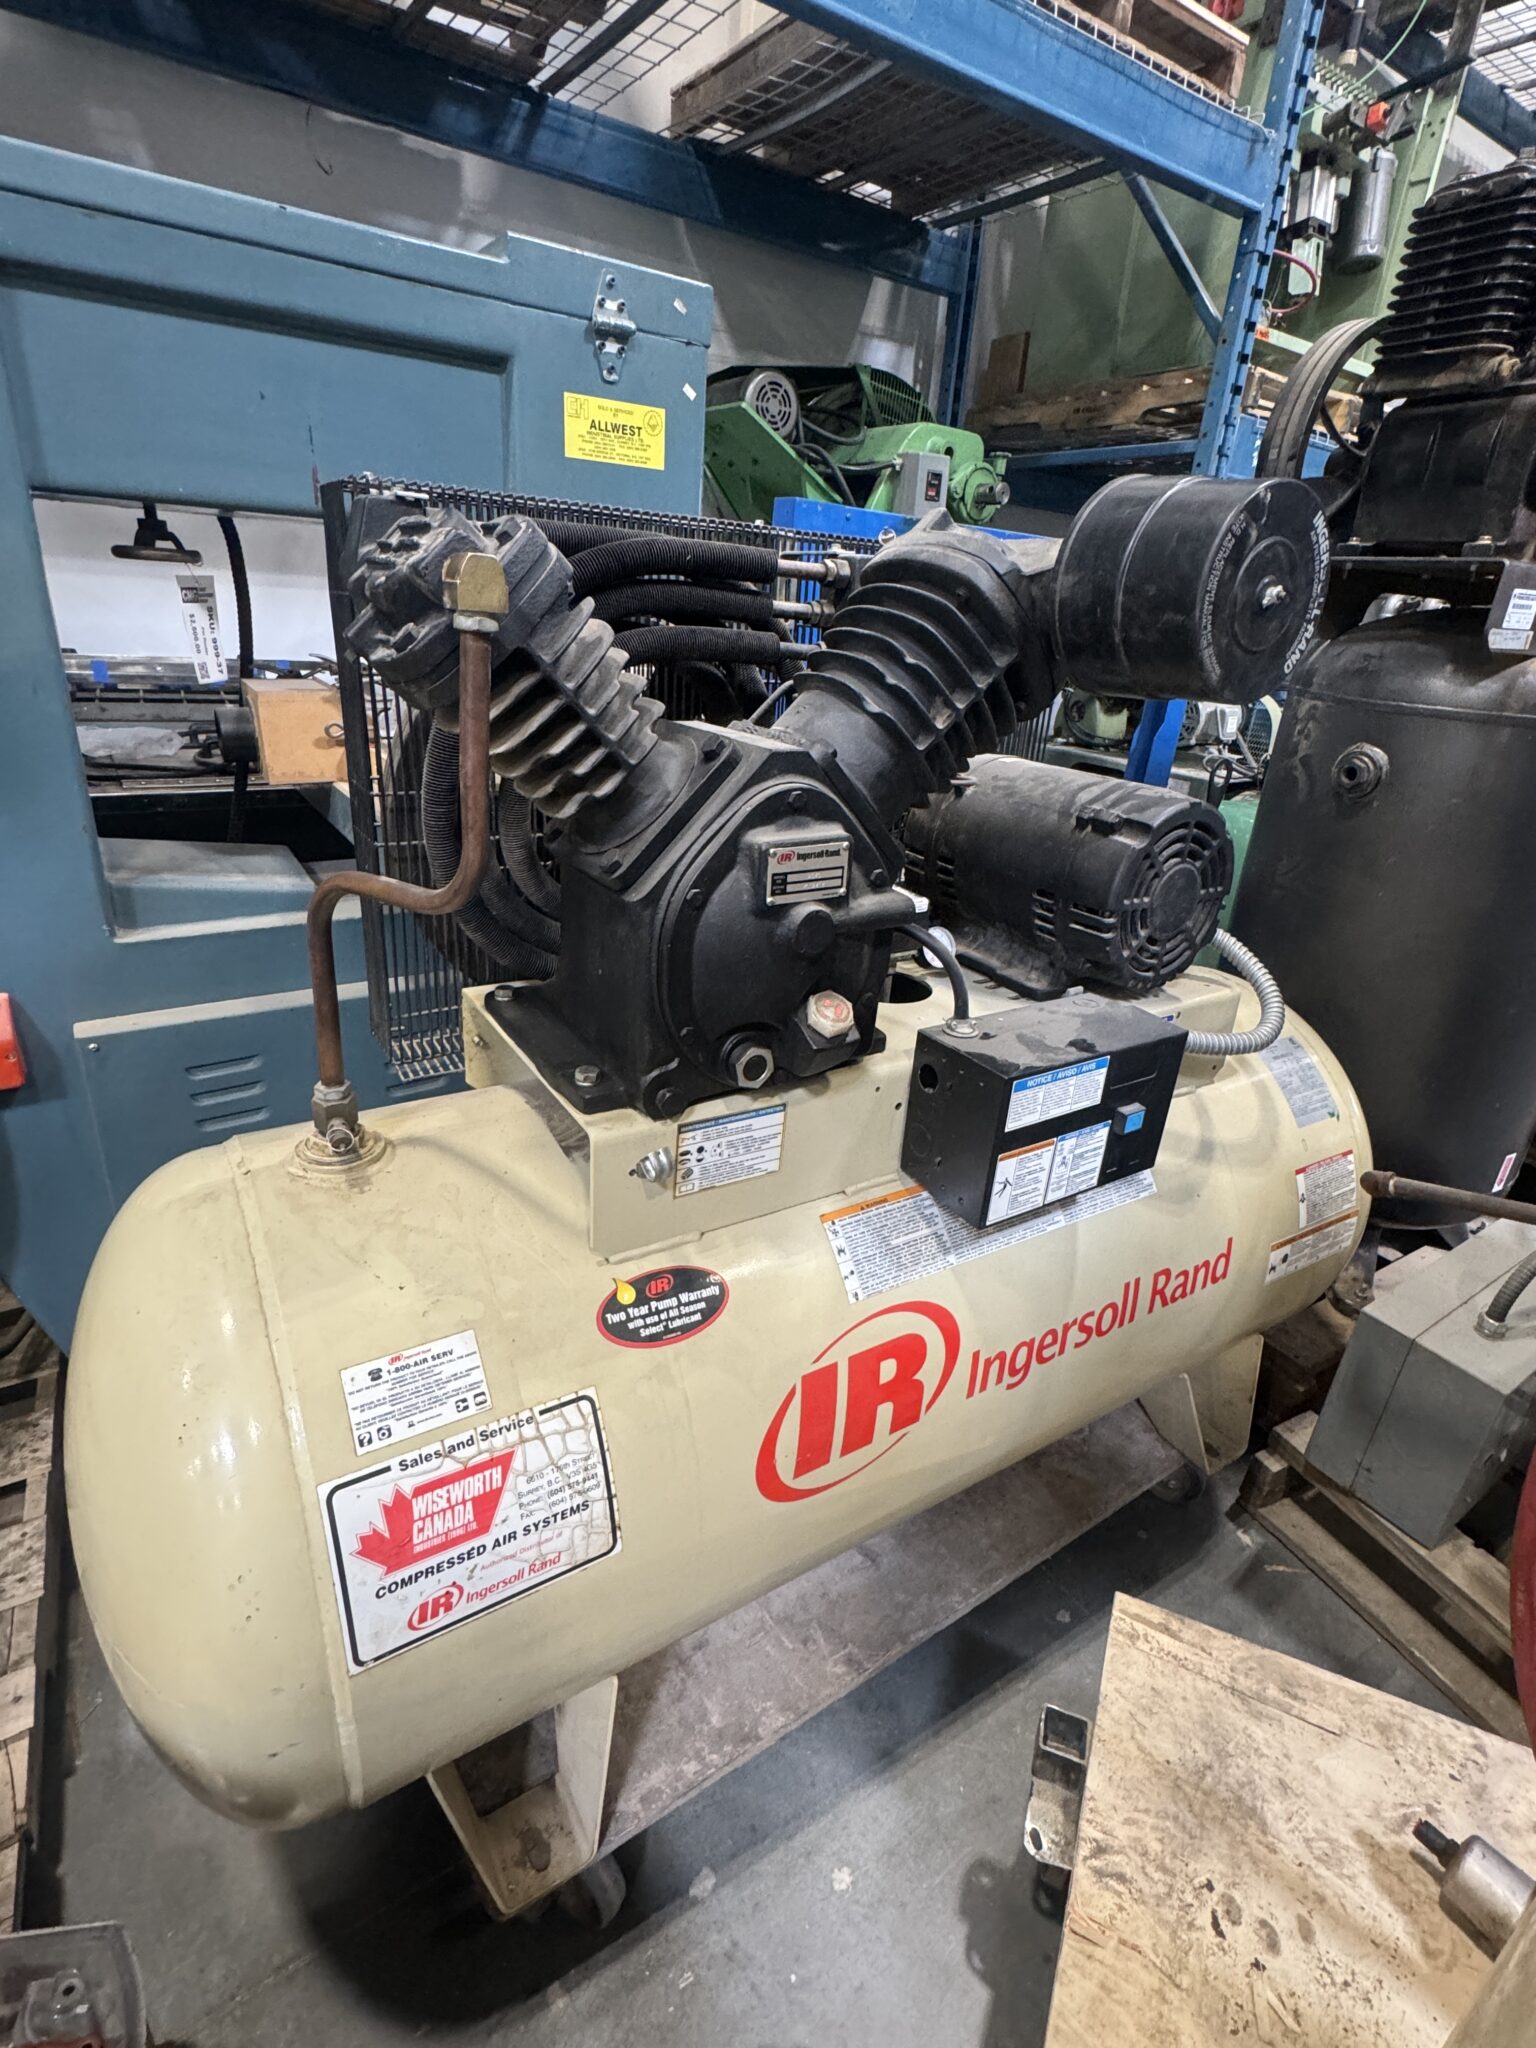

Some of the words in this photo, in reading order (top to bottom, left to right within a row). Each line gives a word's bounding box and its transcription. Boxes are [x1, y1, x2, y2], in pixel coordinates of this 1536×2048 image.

[589, 418, 642, 437] ALLWEST
[1026, 1075, 1052, 1088] NOTICE
[1056, 1067, 1077, 1080] AVISO
[1080, 1062, 1096, 1073] AVIS
[650, 1277, 669, 1295] IR
[605, 1311, 626, 1325] Two
[627, 1305, 649, 1319] Year
[650, 1297, 678, 1313] Pump
[678, 1285, 720, 1304] Warranty
[627, 1317, 645, 1330] with
[645, 1315, 659, 1325] use
[660, 1311, 668, 1320] of
[669, 1307, 679, 1319] All
[680, 1301, 706, 1314] Season
[668, 1312, 702, 1329] Lubricant
[386, 1357, 429, 1376] 1-800-AIR
[431, 1349, 454, 1362] SERV
[793, 1332, 928, 1480] IR
[966, 1276, 1141, 1400] Ingersoll
[1147, 1236, 1234, 1316] Rand
[398, 1448, 443, 1471] Sales
[447, 1434, 475, 1455] and
[479, 1414, 534, 1443] Service
[412, 1465, 502, 1520] WISEWORTH
[547, 1484, 566, 1500] (604)
[413, 1500, 475, 1545] CANADA
[374, 1543, 487, 1600] COMPRESSED
[491, 1531, 518, 1551] AIR
[522, 1500, 590, 1536] SYSTEMS
[417, 1590, 455, 1625] IR
[466, 1567, 525, 1604] Ingersoll
[528, 1552, 561, 1577] Rand
